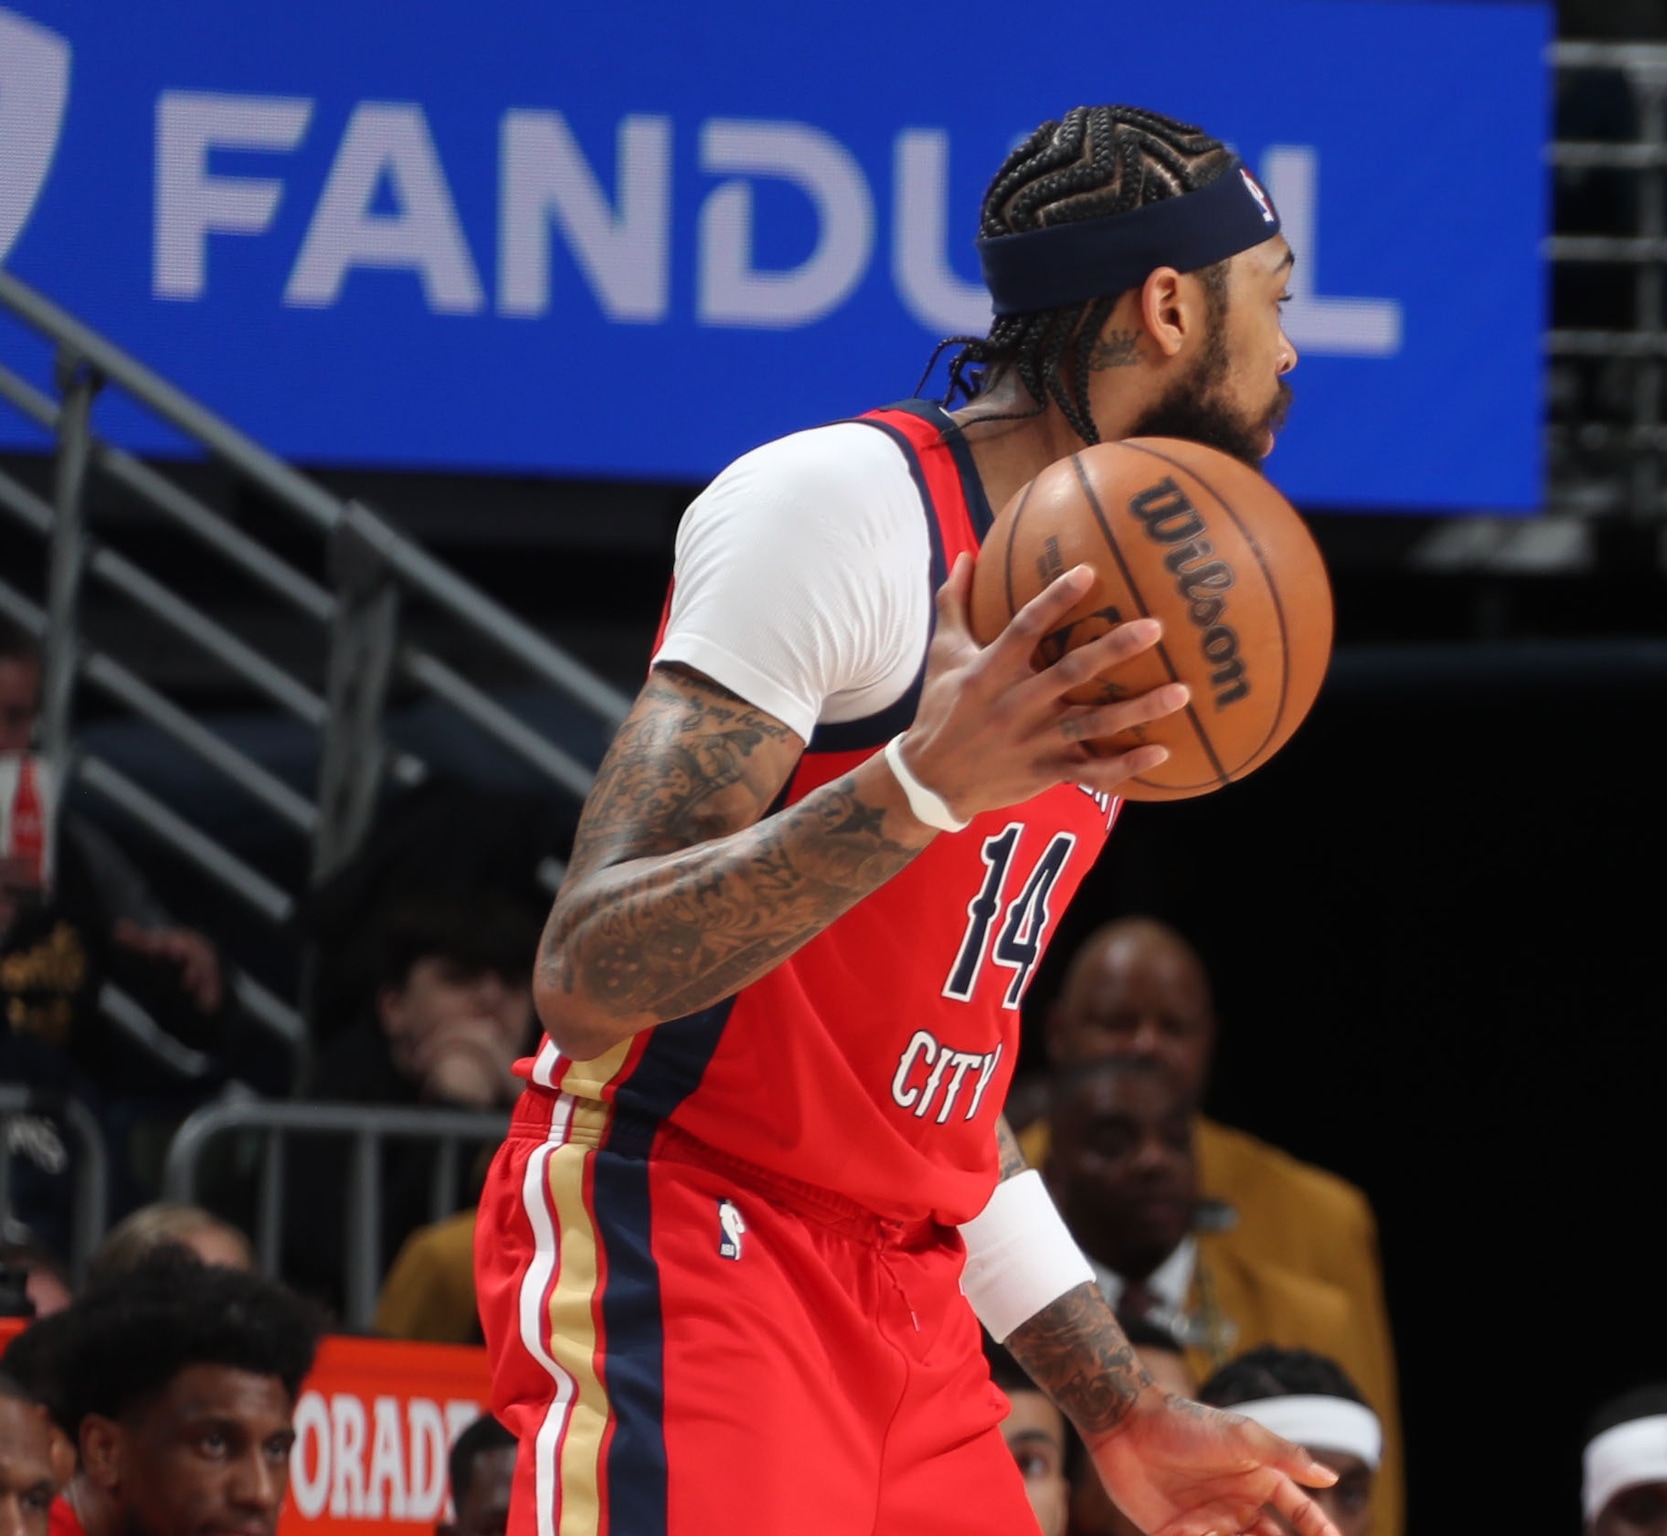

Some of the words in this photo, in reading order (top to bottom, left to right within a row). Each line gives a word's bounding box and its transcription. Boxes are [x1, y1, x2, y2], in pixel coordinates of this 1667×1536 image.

[152, 90, 1402, 357] FANDUL
[1128, 475, 1251, 714] Wilson
[942, 822, 1077, 1010] 14
[891, 1029, 1004, 1125] CITY
